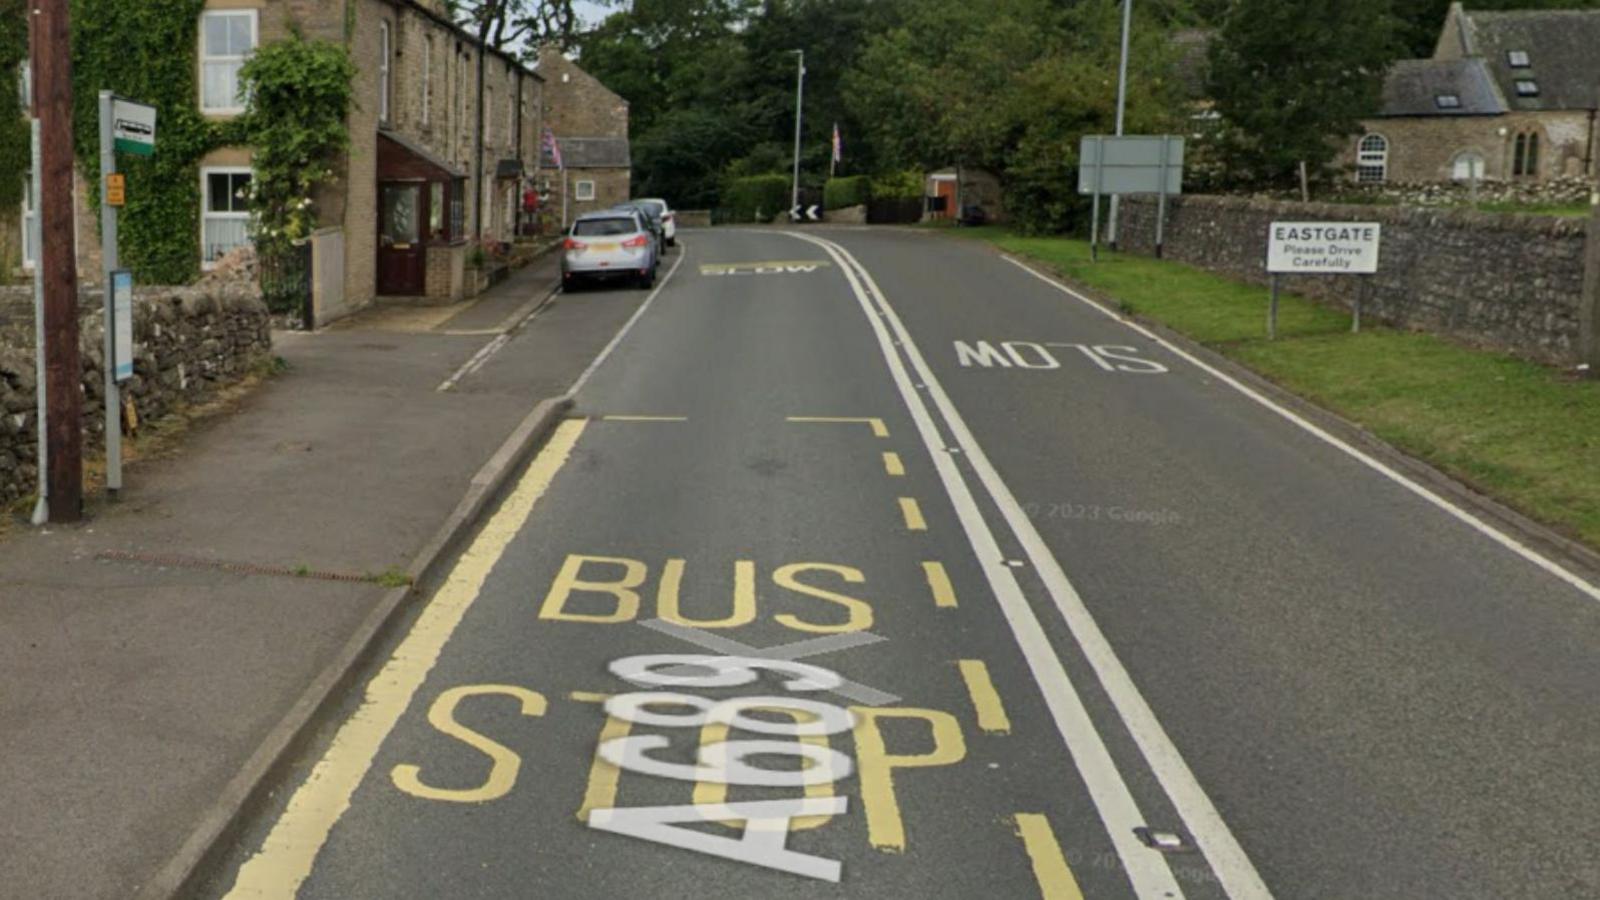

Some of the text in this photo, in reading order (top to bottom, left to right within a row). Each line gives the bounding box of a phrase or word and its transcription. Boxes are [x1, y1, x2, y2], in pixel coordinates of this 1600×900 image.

[1275, 227, 1373, 240] EASTGATE
[1283, 245, 1362, 255] Please Drive
[1292, 257, 1351, 268] Carefully
[953, 340, 1168, 373] SLOW
[538, 553, 875, 634] BUS
[391, 684, 967, 853] STOP
